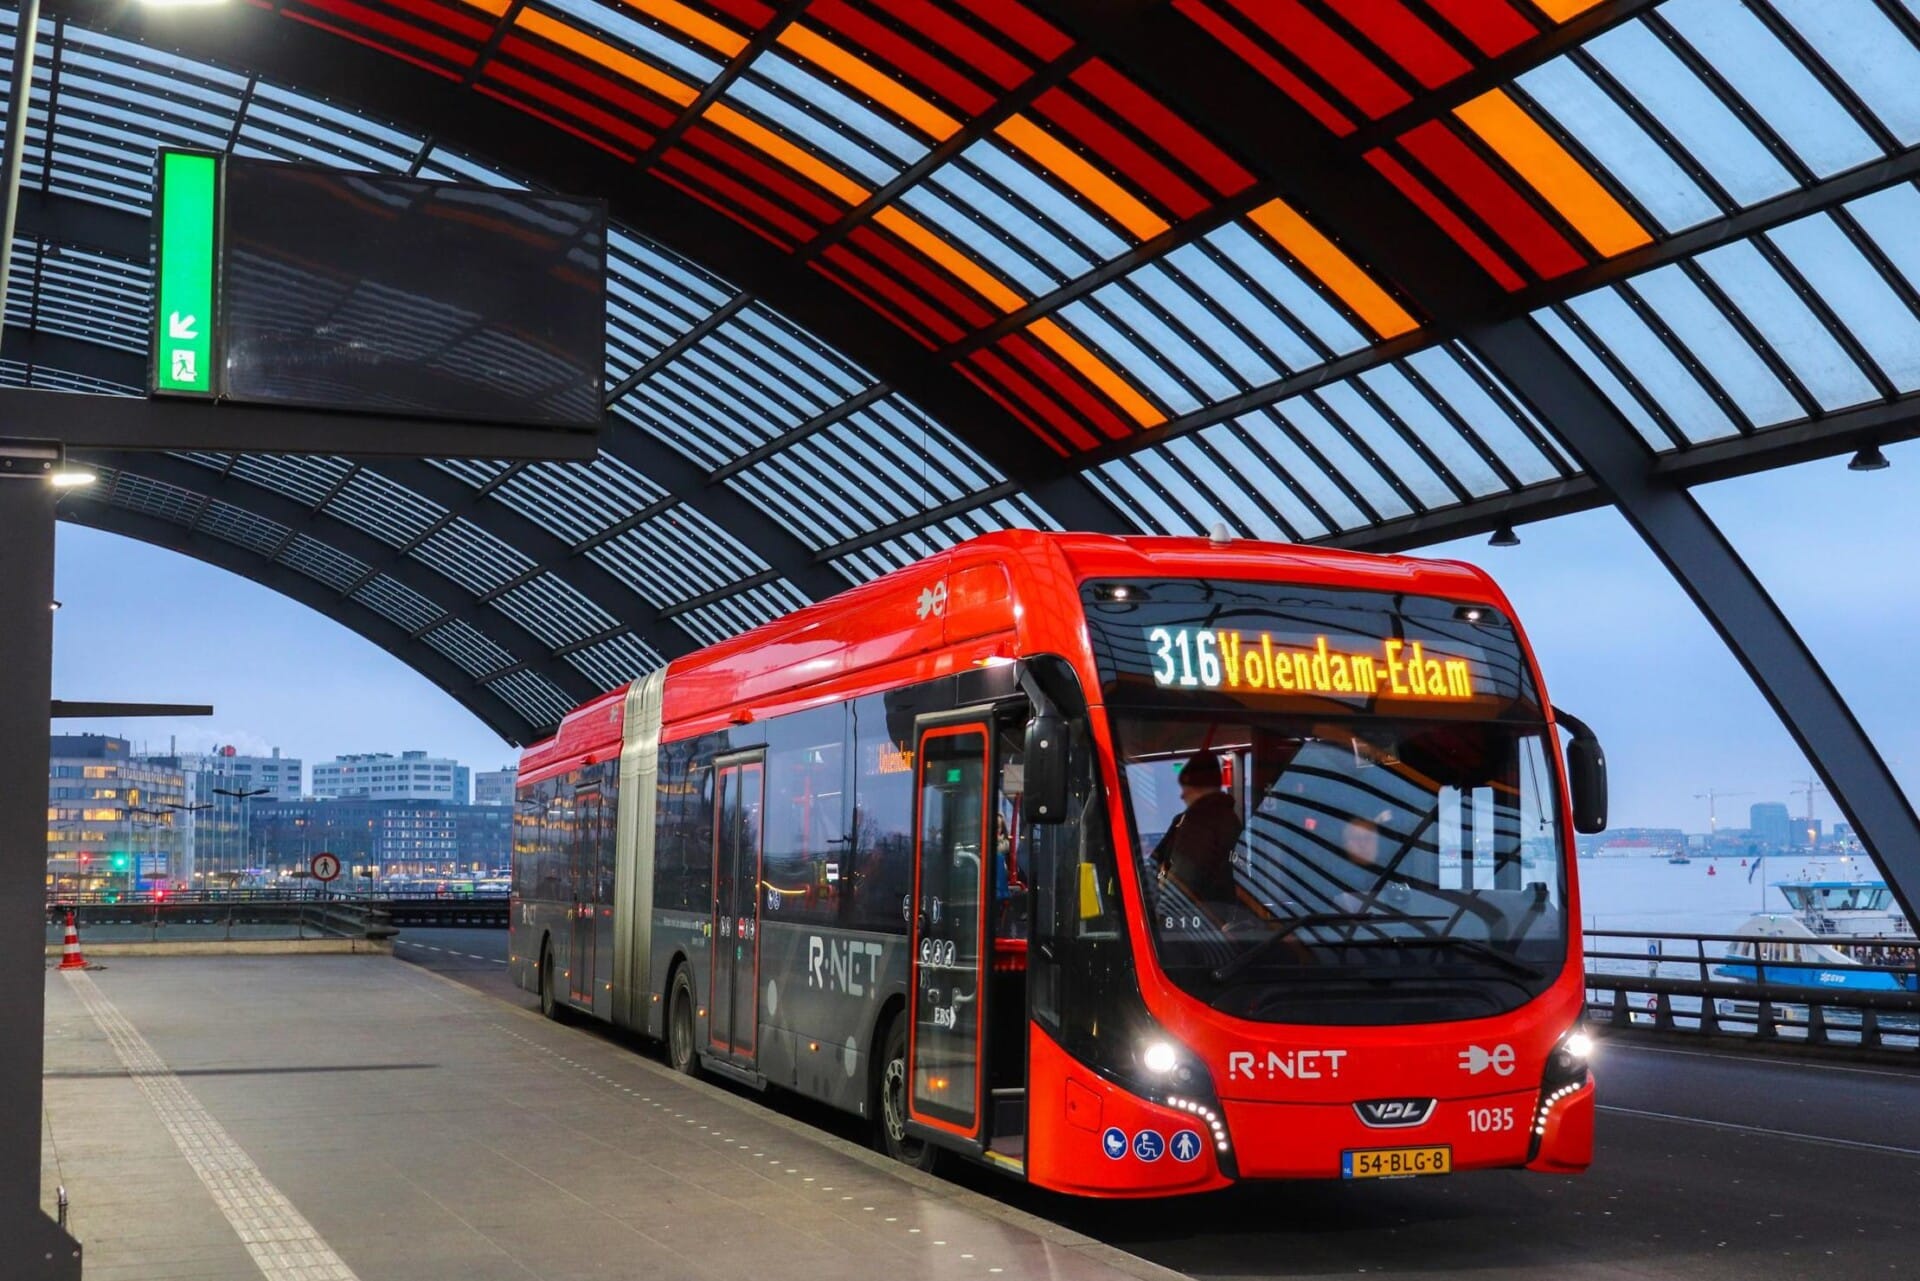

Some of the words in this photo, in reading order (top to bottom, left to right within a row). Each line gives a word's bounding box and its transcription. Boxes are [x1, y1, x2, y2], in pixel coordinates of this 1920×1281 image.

[1150, 628, 1221, 687] 316
[1218, 631, 1472, 698] Volendam-Edam
[934, 1007, 951, 1027] EBS
[1366, 1101, 1421, 1120] VDL
[1467, 1107, 1514, 1133] 1035
[1359, 1151, 1444, 1174] 54-BLG-8
